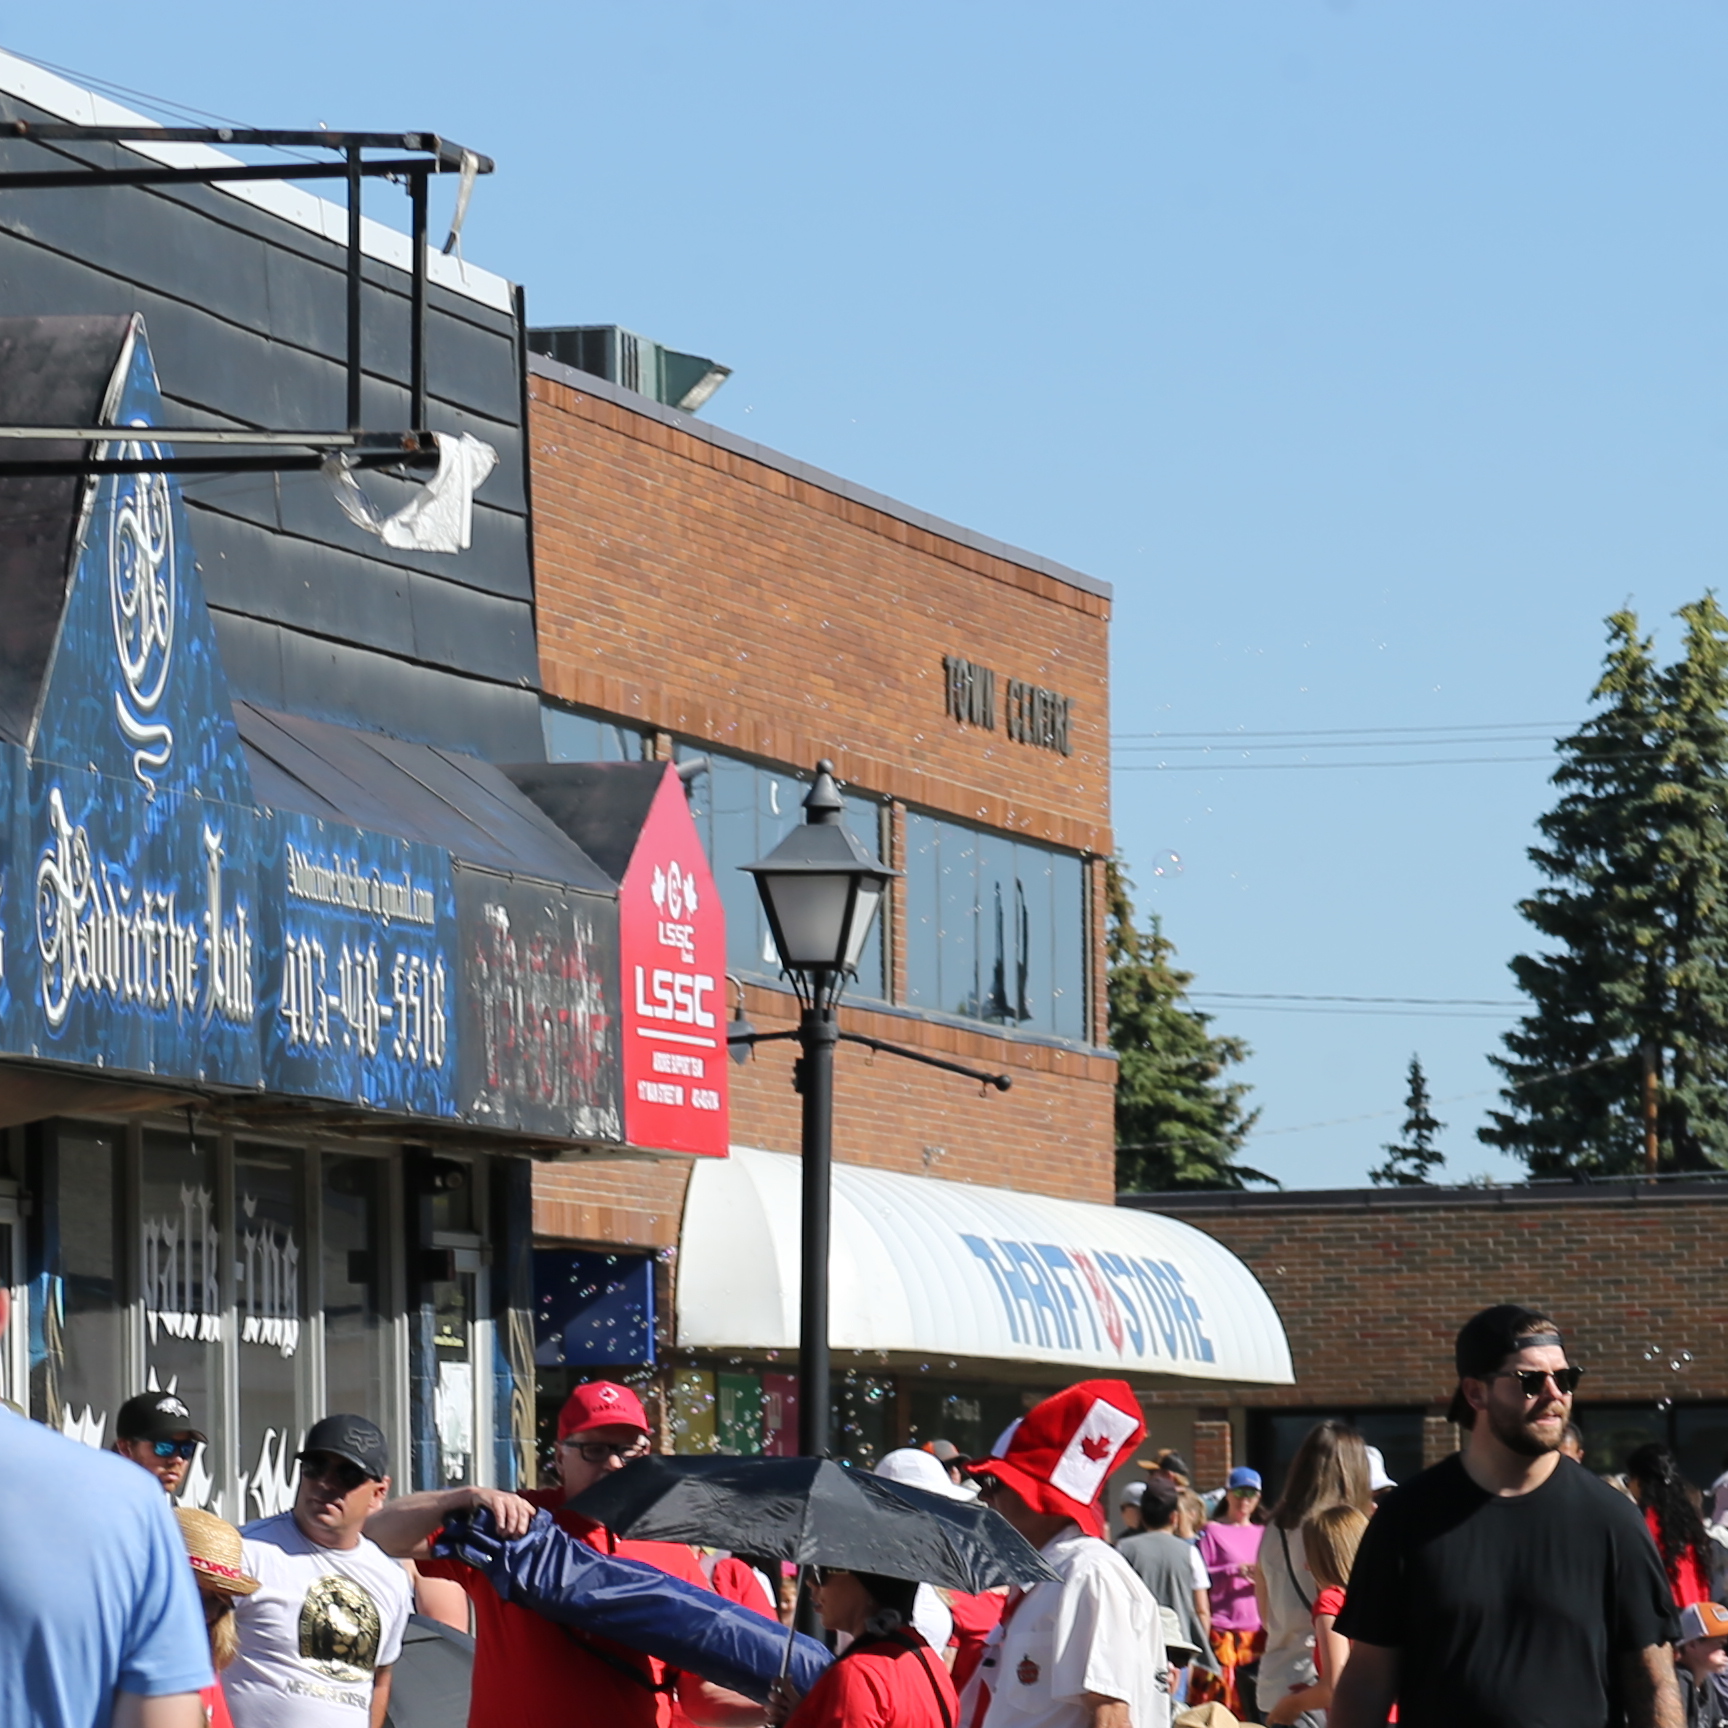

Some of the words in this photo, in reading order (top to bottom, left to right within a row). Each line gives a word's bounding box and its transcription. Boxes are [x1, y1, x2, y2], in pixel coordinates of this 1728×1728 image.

[203, 823, 255, 1030] Ink
[658, 920, 695, 950] LSSC
[634, 965, 716, 1028] LSSC
[958, 1233, 1102, 1351] THRIFT
[1092, 1248, 1216, 1363] STORE
